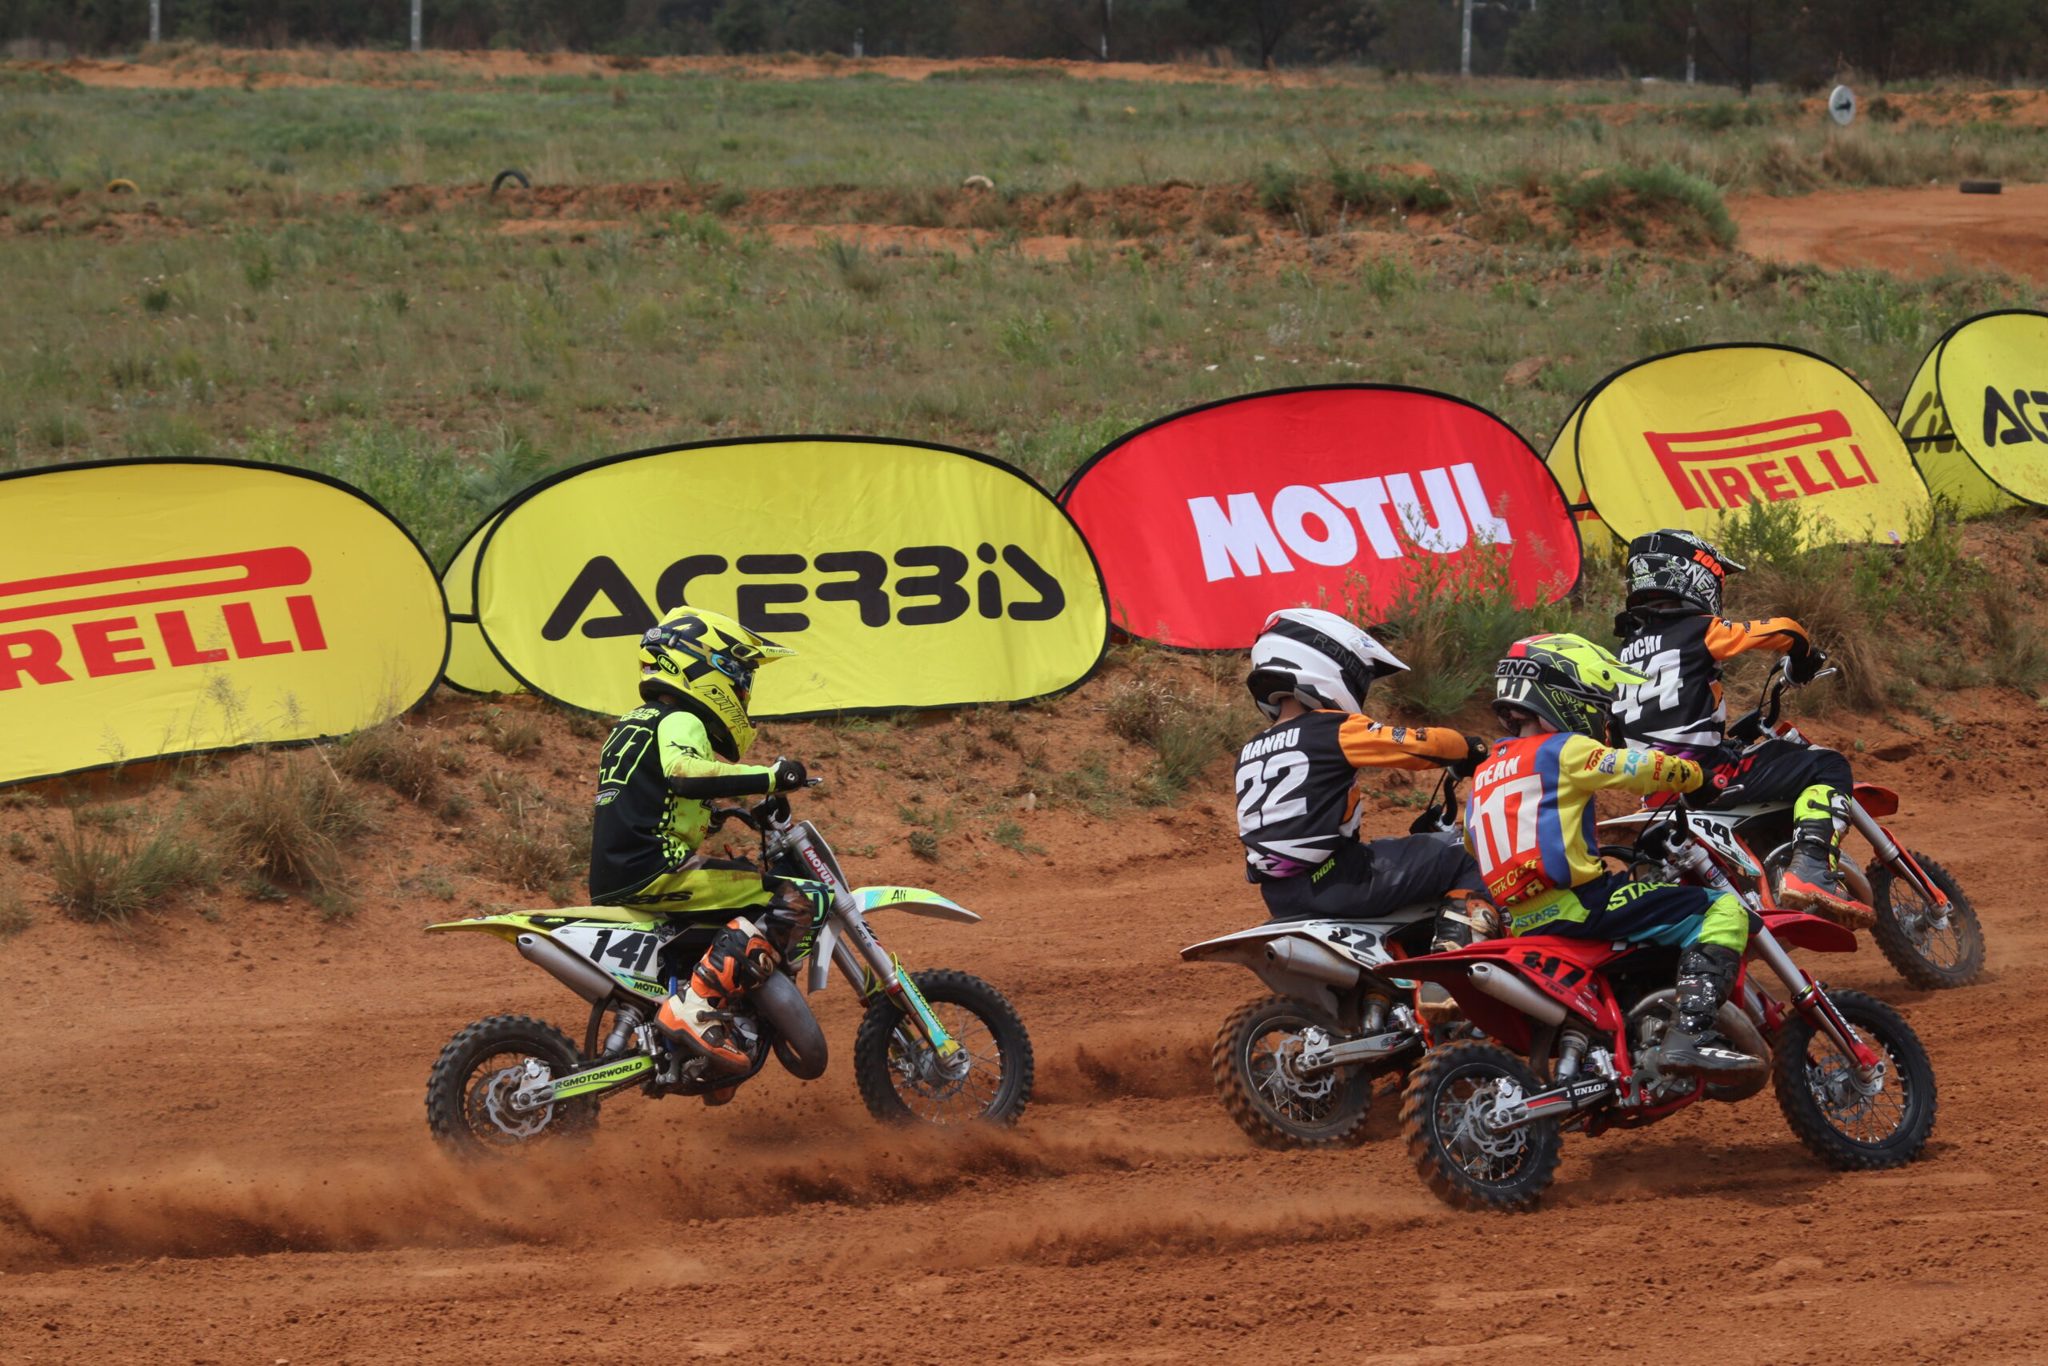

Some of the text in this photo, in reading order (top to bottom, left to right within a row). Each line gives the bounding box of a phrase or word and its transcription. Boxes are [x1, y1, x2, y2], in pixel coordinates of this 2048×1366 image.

[1643, 409, 1879, 511] PIRELLI
[1186, 462, 1513, 583] MOTUL
[0, 546, 328, 691] RELLI
[659, 657, 677, 674] BELL
[1611, 648, 1684, 724] 44
[1240, 727, 1301, 764] HANRU
[1474, 755, 1521, 793] DEAN
[1235, 750, 1310, 838] 22
[1469, 773, 1544, 877] 117
[804, 848, 835, 886] MOTUL
[1311, 858, 1336, 884] THOR
[891, 889, 907, 901] Ali
[590, 929, 660, 973] 141
[633, 981, 665, 996] MOTUL
[554, 1061, 644, 1091] RGMOTORWORLD
